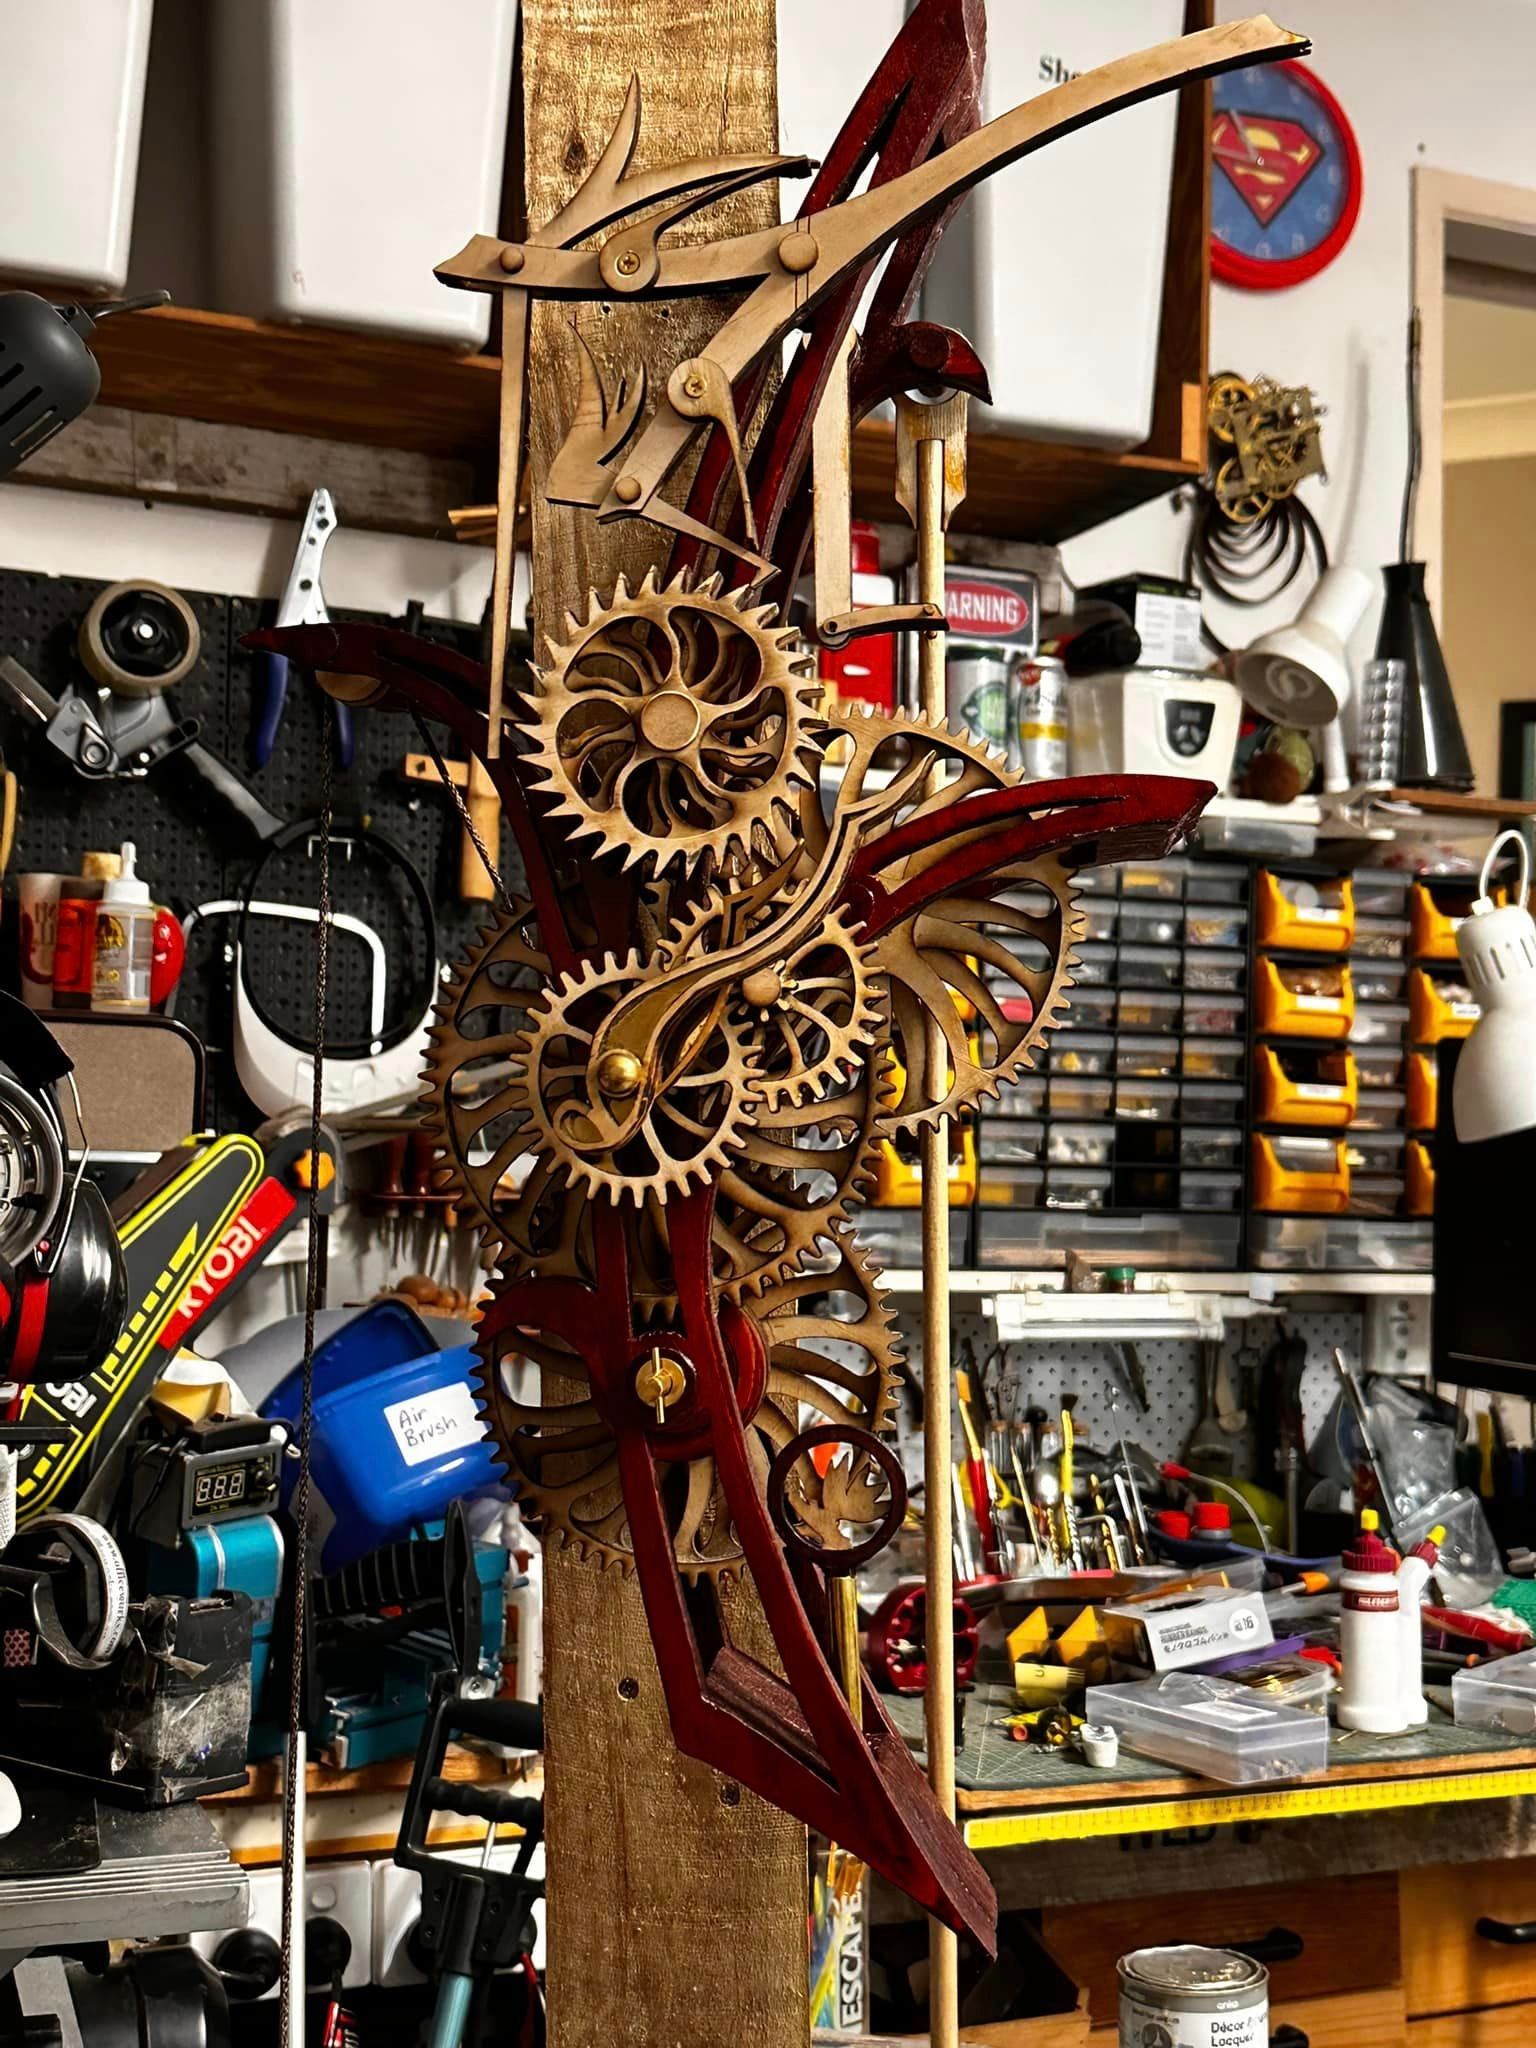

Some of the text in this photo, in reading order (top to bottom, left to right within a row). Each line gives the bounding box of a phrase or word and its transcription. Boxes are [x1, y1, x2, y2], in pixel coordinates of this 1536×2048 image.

[946, 591, 1020, 626] ARNING
[399, 1407, 427, 1429] Air
[404, 1416, 458, 1447] Brush
[1211, 2021, 1245, 2033] Décor
